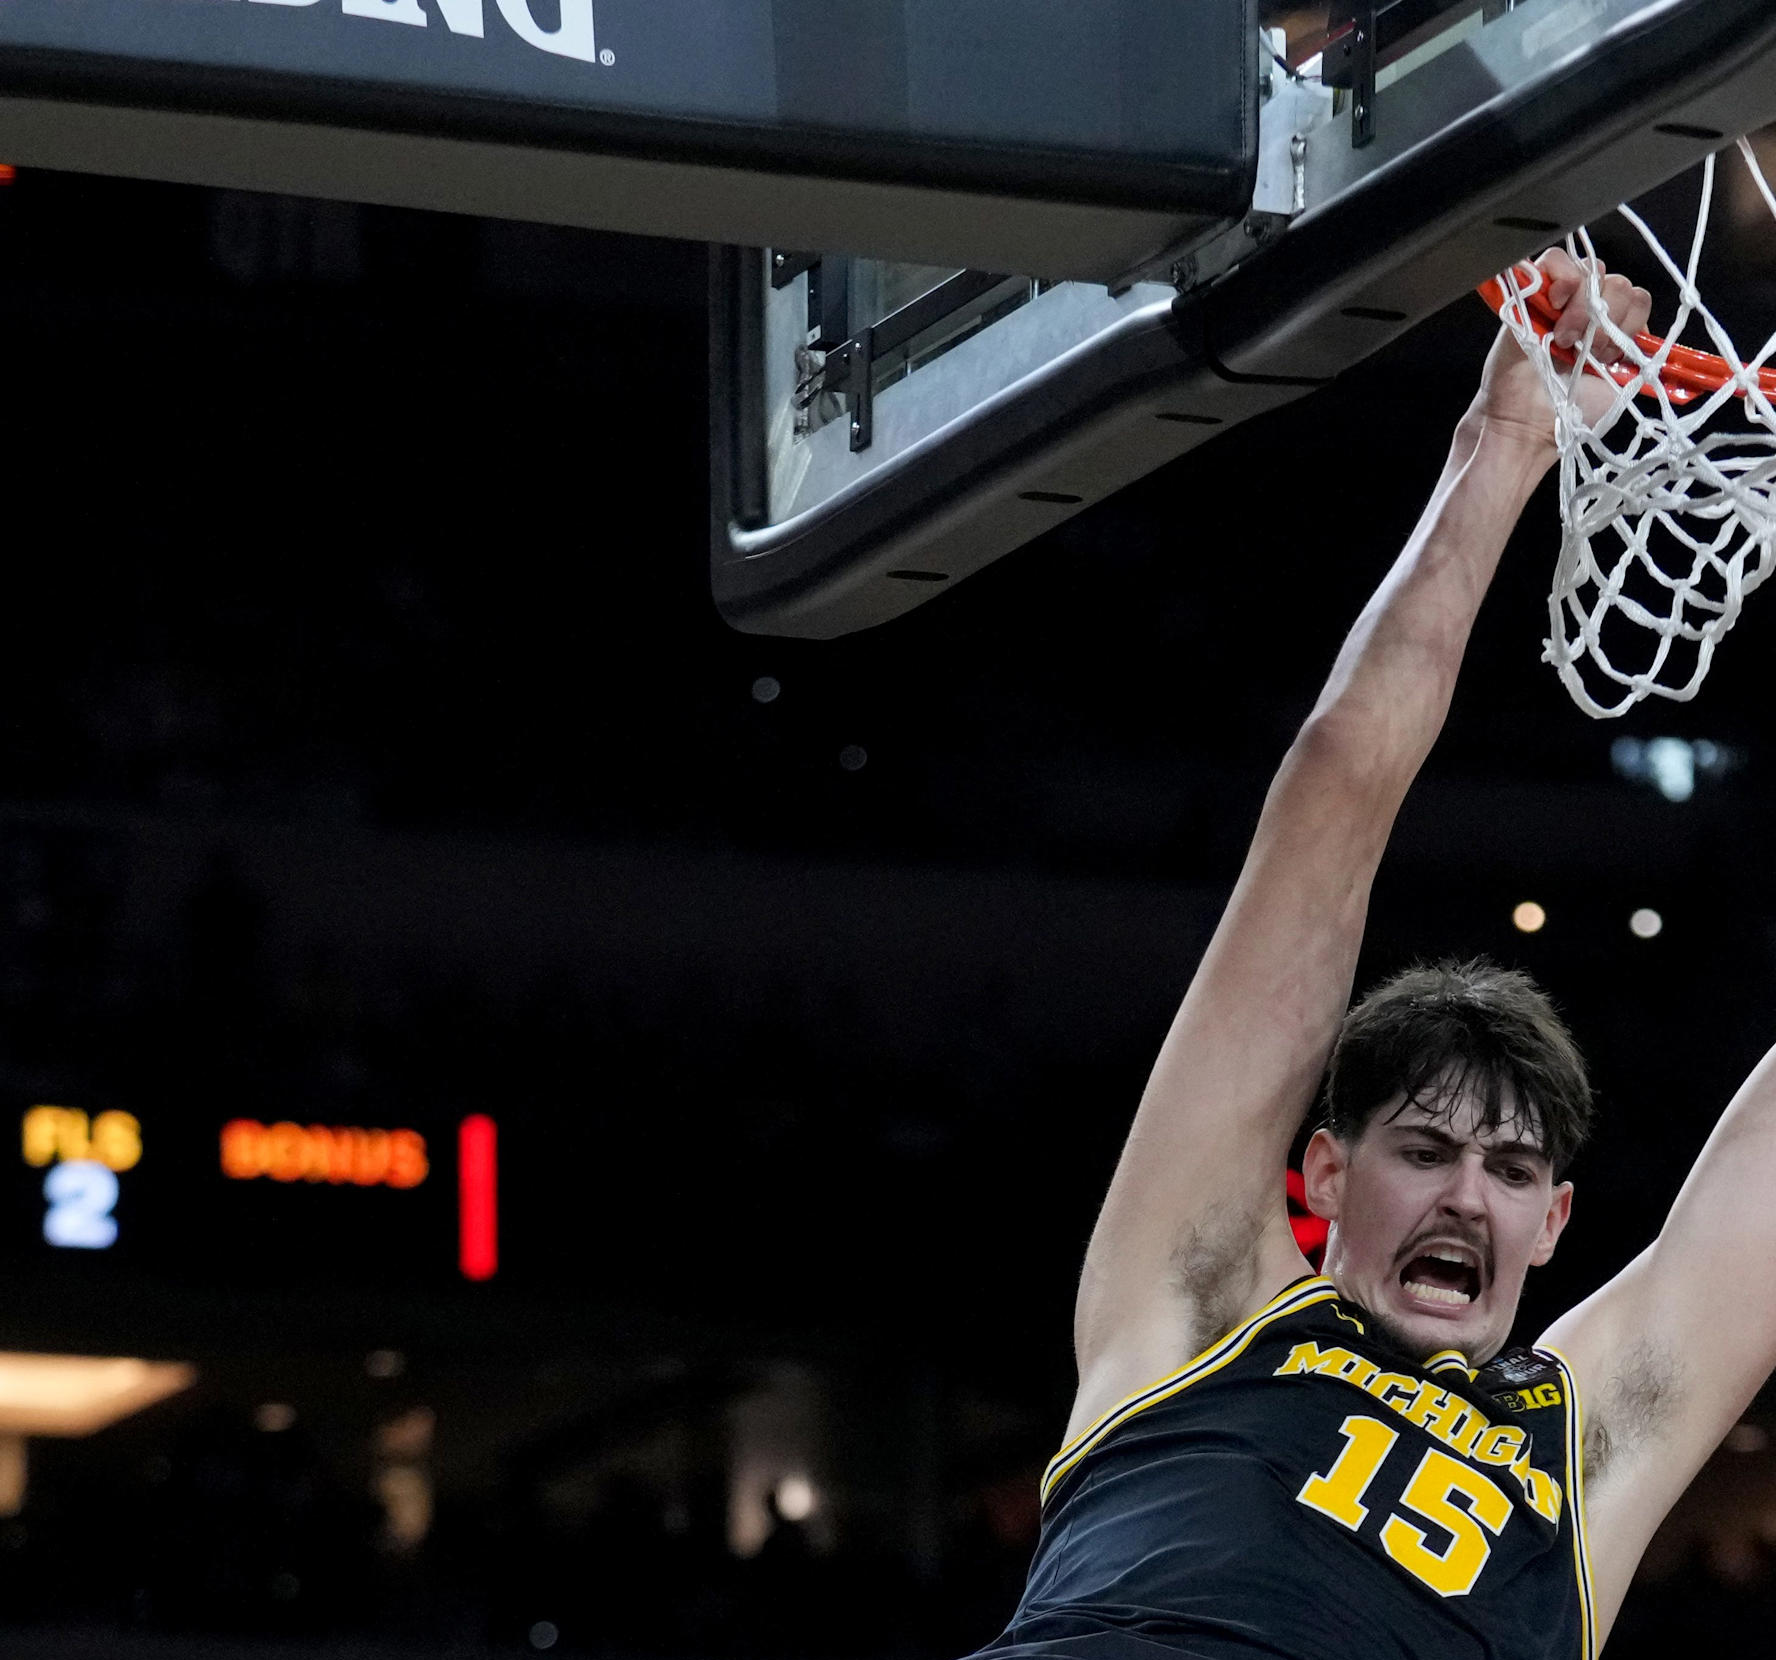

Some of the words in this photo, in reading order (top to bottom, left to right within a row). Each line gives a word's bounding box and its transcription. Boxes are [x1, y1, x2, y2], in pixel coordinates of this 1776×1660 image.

[43, 1159, 119, 1249] 2
[1272, 1340, 1563, 1536] MICHIG
[1296, 1414, 1514, 1598] 15
